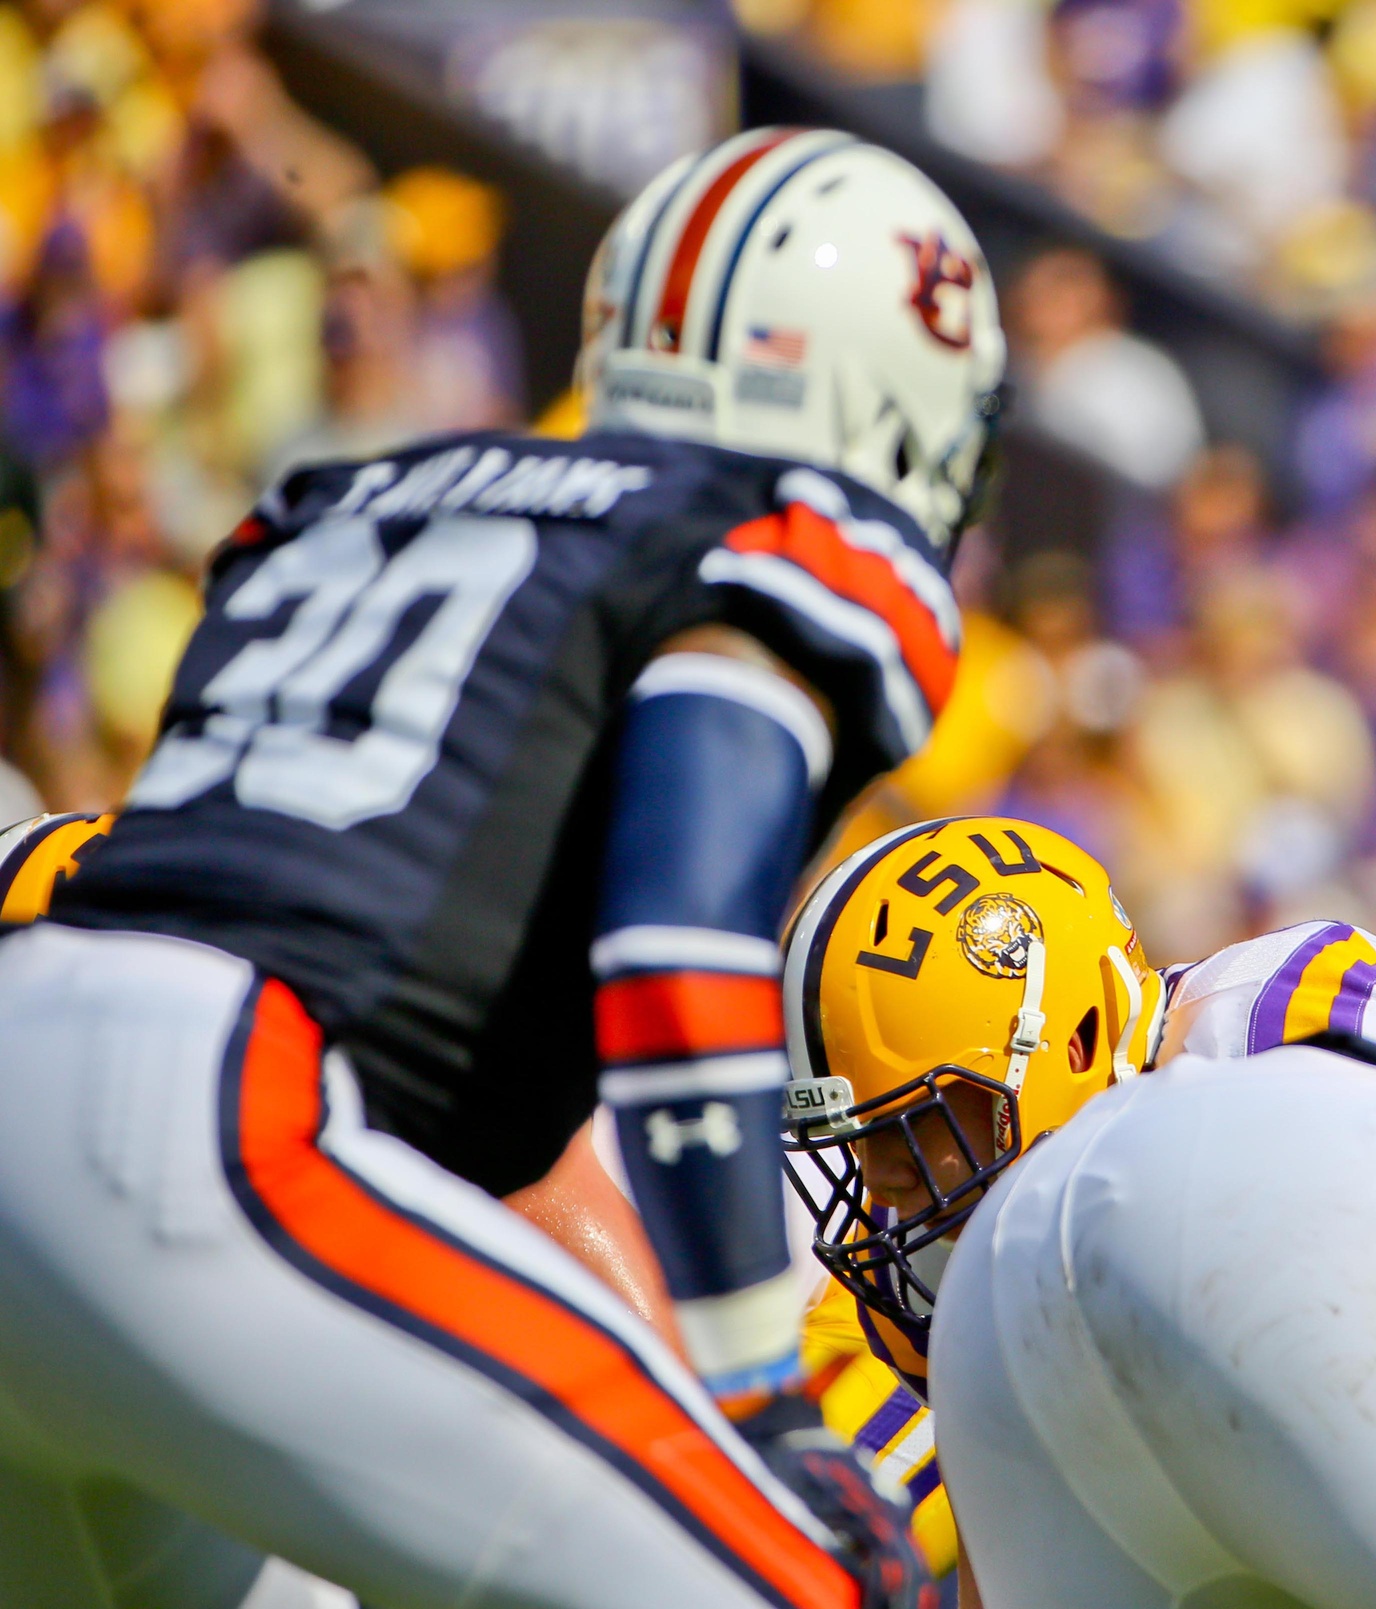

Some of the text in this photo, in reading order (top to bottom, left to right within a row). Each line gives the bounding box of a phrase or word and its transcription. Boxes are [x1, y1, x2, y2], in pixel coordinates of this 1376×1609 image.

[122, 514, 540, 832] 30
[855, 830, 1042, 981] LSU
[786, 1086, 826, 1109] LSU
